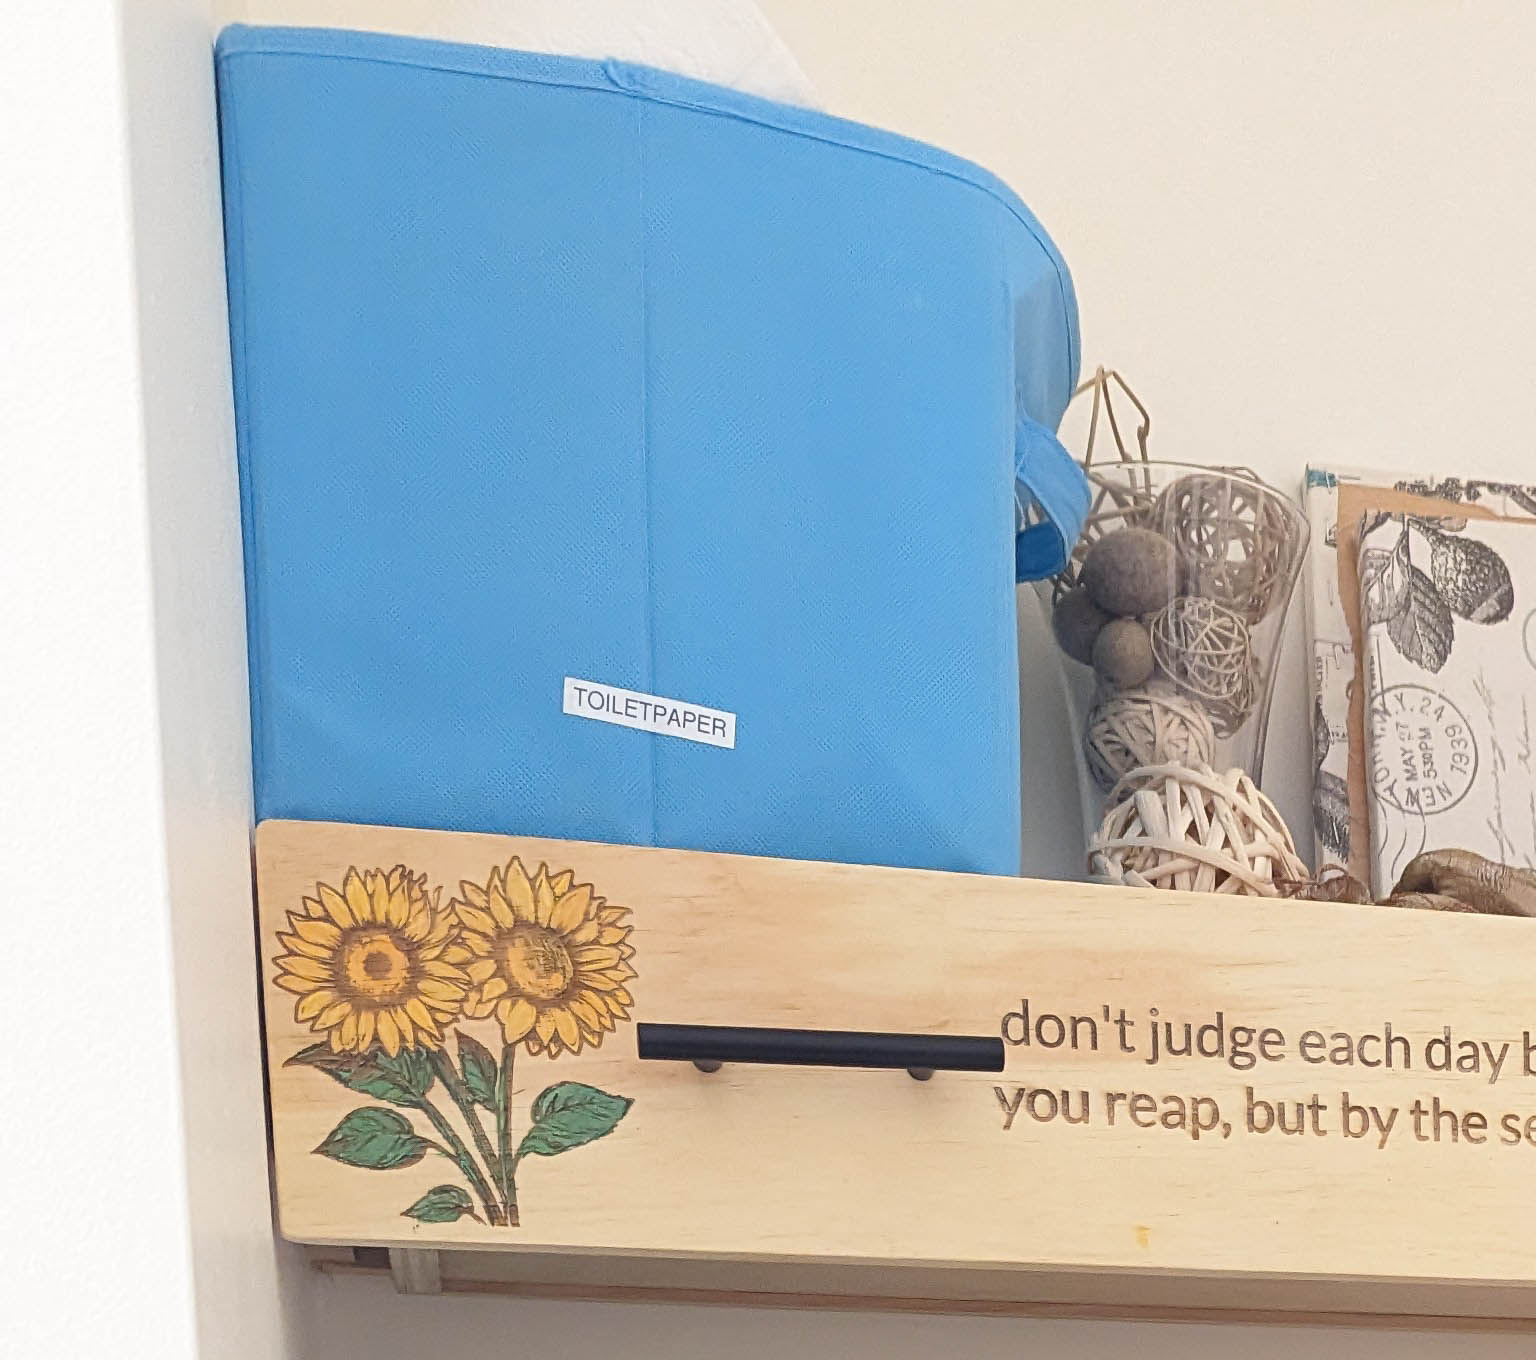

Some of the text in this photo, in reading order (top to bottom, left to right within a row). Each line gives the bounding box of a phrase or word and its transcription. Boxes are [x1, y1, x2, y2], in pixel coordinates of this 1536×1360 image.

[572, 685, 727, 738] TOILETPAPER
[1444, 724, 1470, 775] 1939
[1001, 998, 1136, 1053] don't
[1145, 1007, 1286, 1070] judge
[1299, 1021, 1411, 1069] each
[1424, 1025, 1510, 1085] day
[993, 1085, 1090, 1131] you
[1105, 1091, 1232, 1141] reap,
[1245, 1085, 1328, 1136] but
[1342, 1091, 1399, 1150] by
[1409, 1096, 1488, 1145] the
